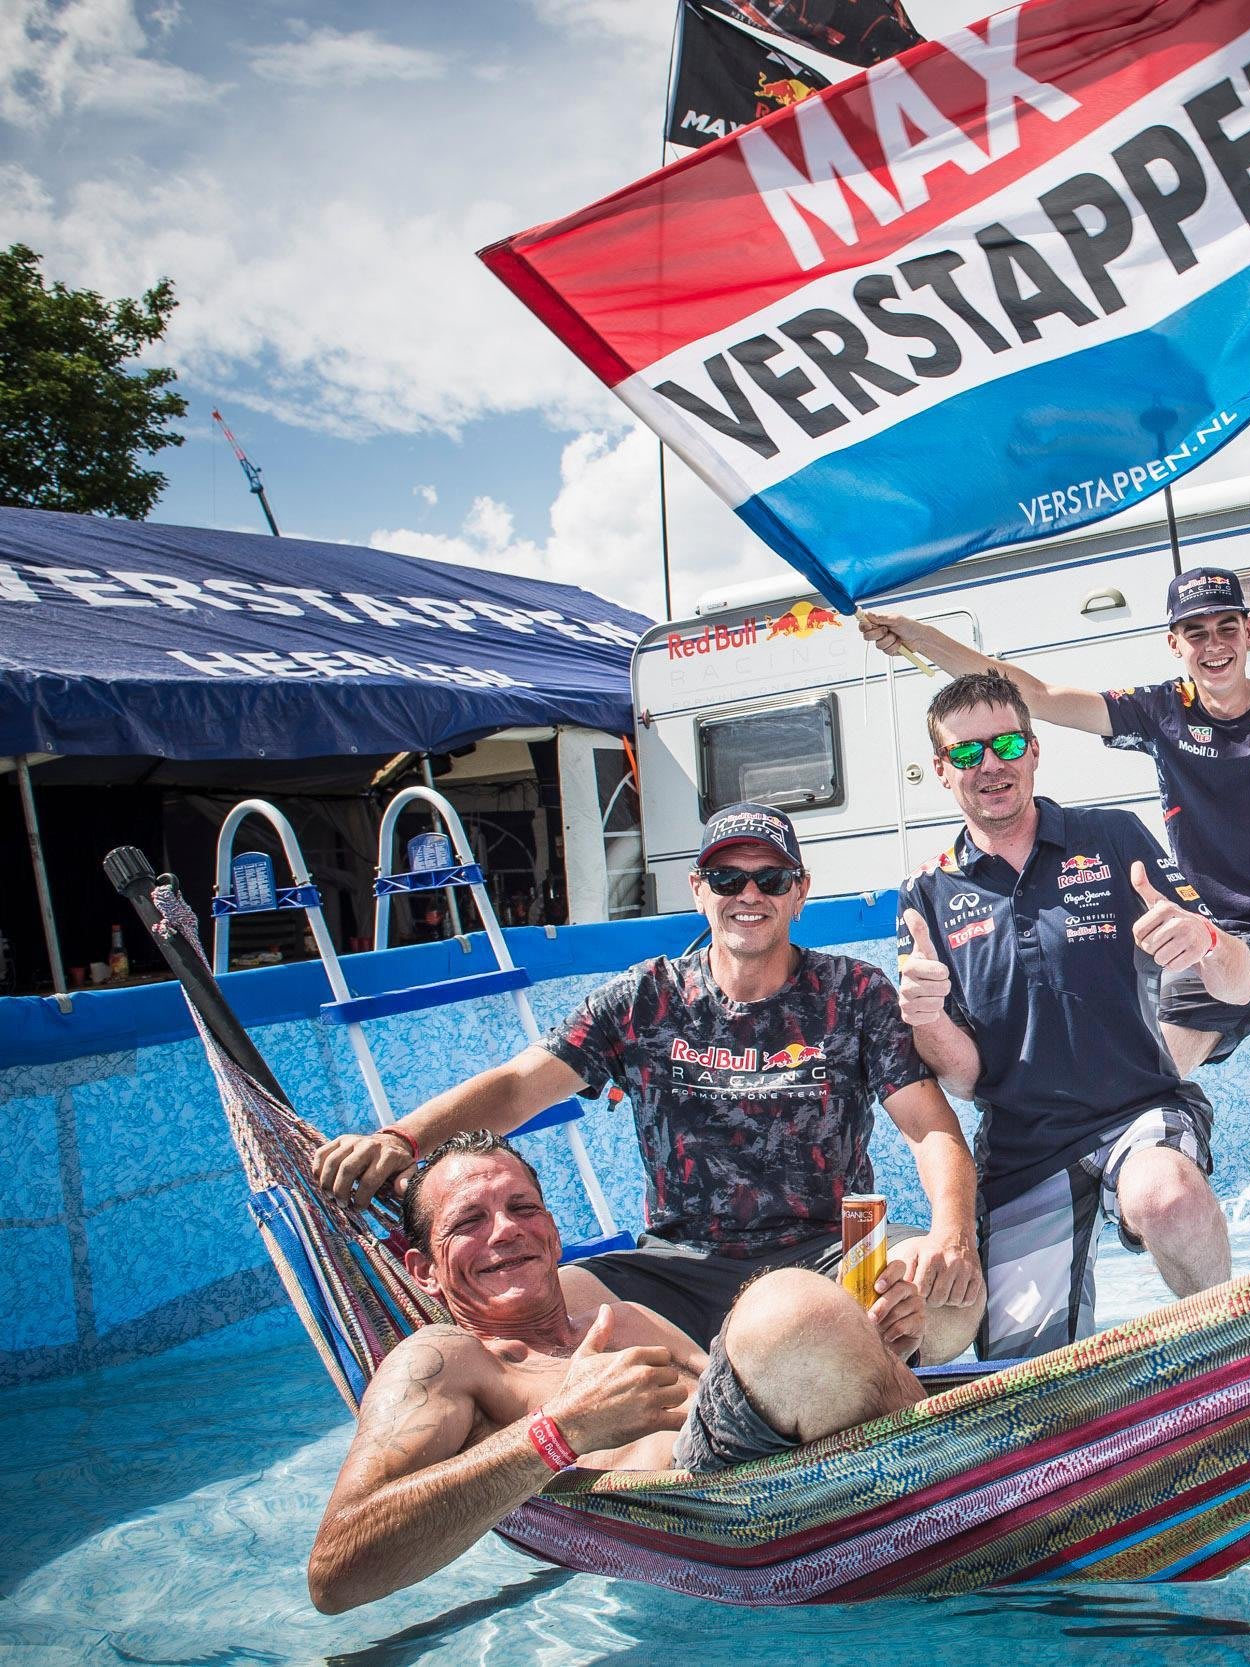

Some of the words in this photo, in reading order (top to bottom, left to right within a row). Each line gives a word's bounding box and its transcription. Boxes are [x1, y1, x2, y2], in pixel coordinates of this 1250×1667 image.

[736, 4, 1083, 271] MAX
[1018, 410, 1238, 526] VERSTAPPEN.NL
[668, 626, 711, 660] Red
[714, 615, 758, 651] Bull
[166, 651, 535, 688] HEERLEN
[1178, 739, 1207, 757] Mobil
[1057, 869, 1085, 889] Red
[1084, 864, 1112, 883] Bull
[1063, 892, 1086, 905] Pepe
[1084, 890, 1112, 903] Jeans
[944, 904, 993, 929] INFINITI
[1082, 912, 1116, 921] INFINITI
[671, 1037, 716, 1068] Red
[713, 1047, 758, 1073] Bull
[672, 1065, 827, 1088] RACING
[671, 1088, 739, 1101] FORMULA
[747, 1092, 779, 1100] ONE
[788, 1089, 828, 1098] TEAM
